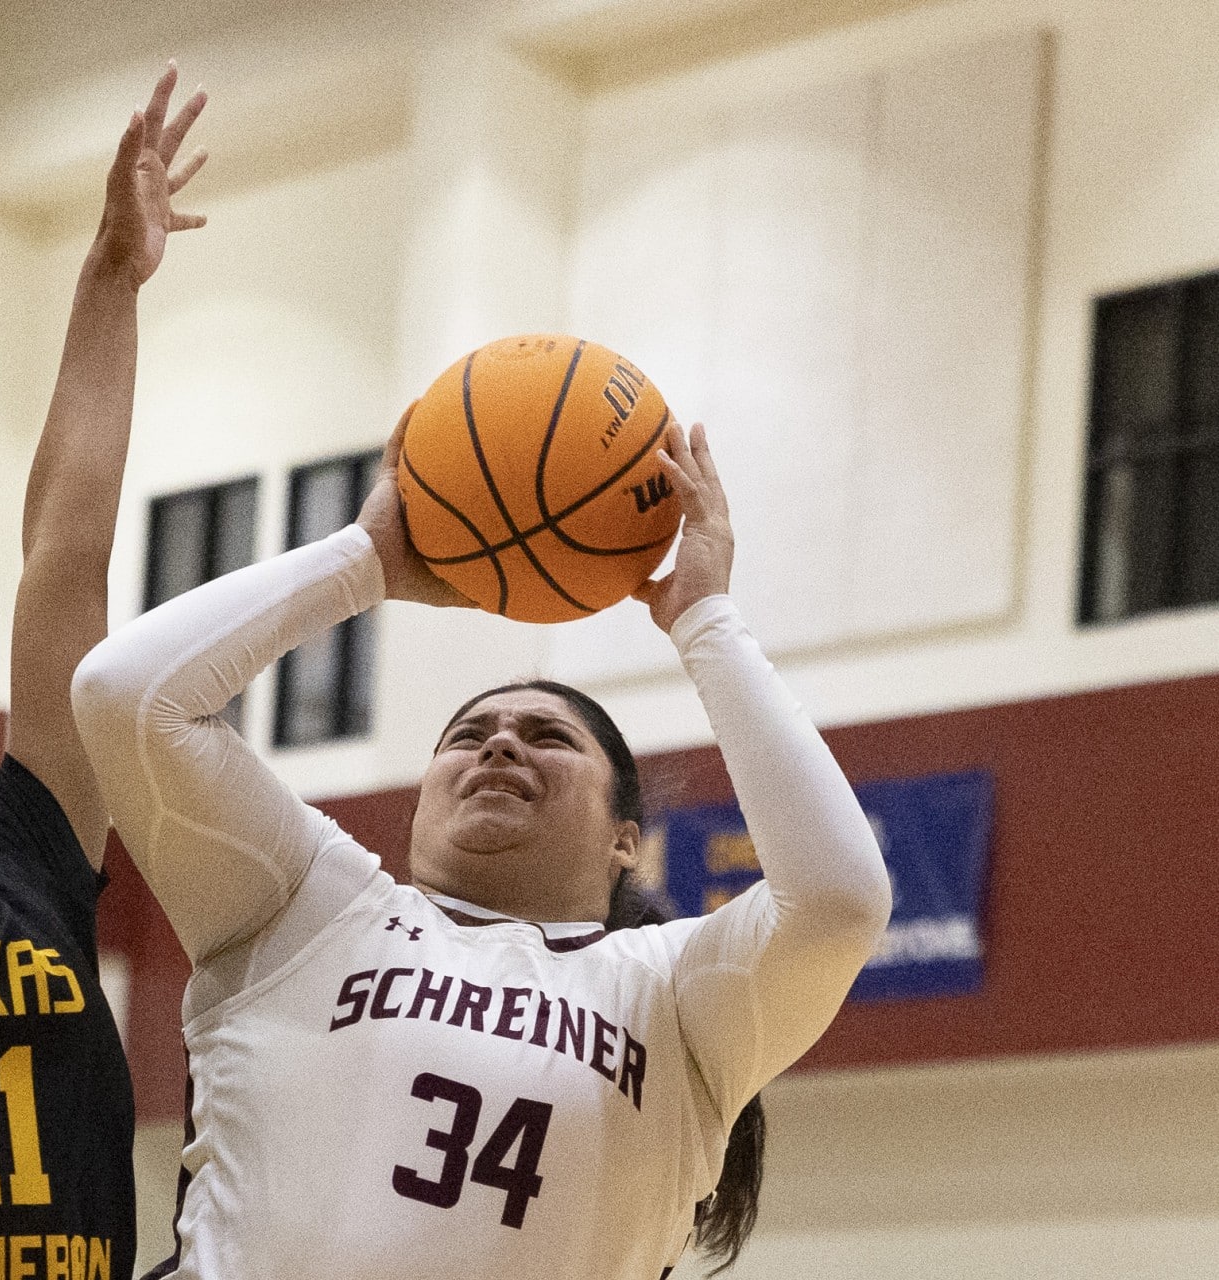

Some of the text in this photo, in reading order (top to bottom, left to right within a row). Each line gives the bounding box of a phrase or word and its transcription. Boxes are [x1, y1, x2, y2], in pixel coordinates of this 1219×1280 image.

[600, 416, 623, 449] NXT
[329, 967, 647, 1112] SCHREINER
[392, 1072, 553, 1230] 34
